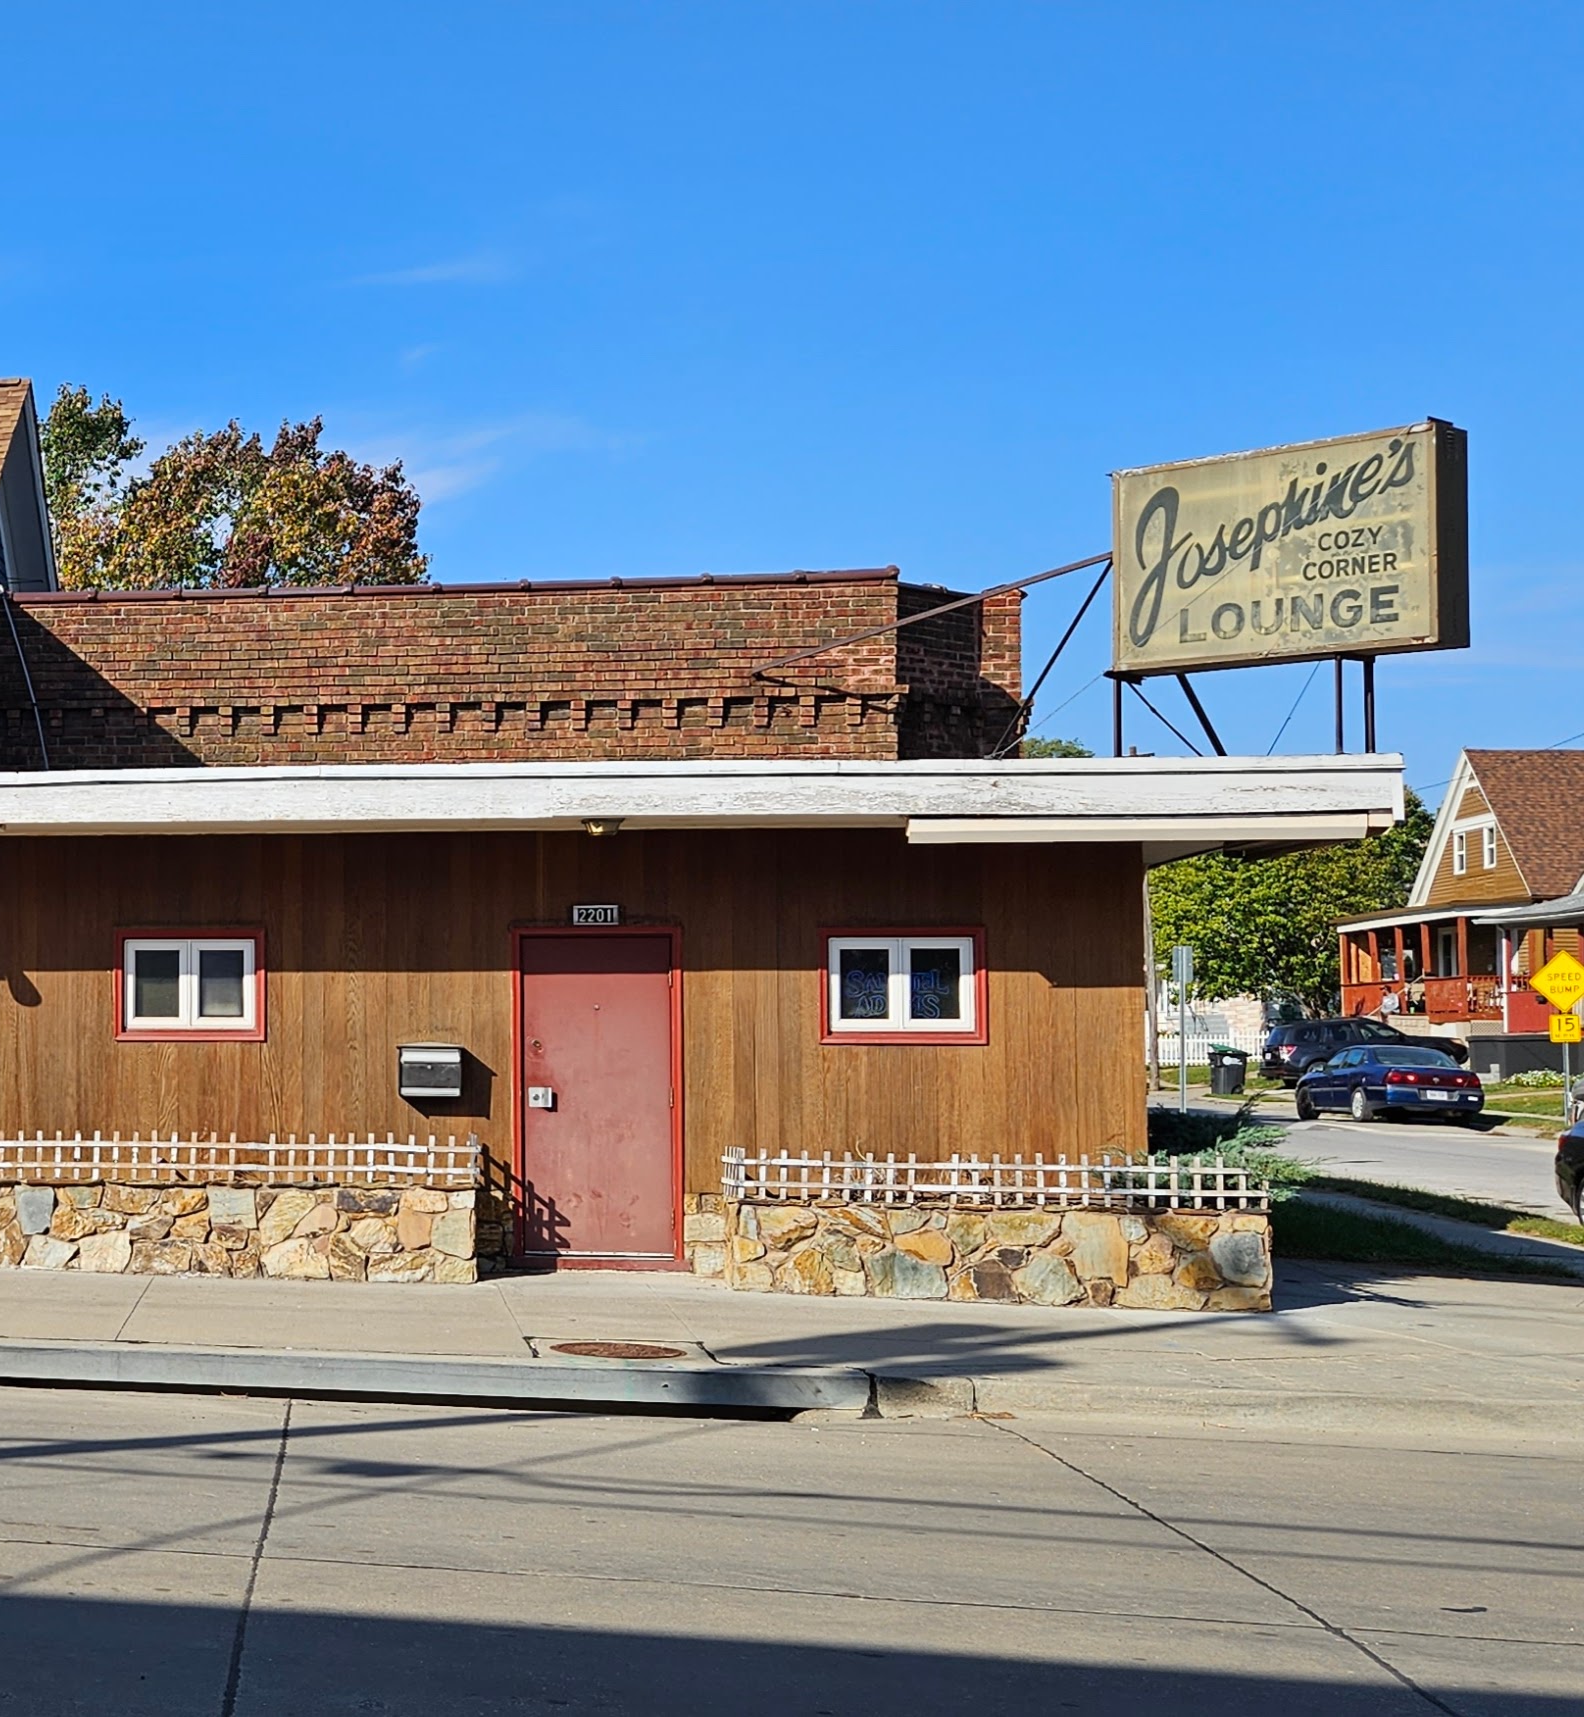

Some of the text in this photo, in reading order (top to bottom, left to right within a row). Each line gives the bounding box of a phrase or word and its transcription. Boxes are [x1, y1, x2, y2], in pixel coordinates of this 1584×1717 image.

[1129, 438, 1416, 648] Josephine's
[1318, 525, 1384, 552] COZY
[1302, 552, 1397, 581] CORNER
[1179, 585, 1400, 644] LOUNGE
[579, 909, 611, 922] 2201
[1547, 973, 1581, 981] SPEED
[1550, 985, 1579, 994] BUMP
[1557, 1018, 1575, 1031] 15
